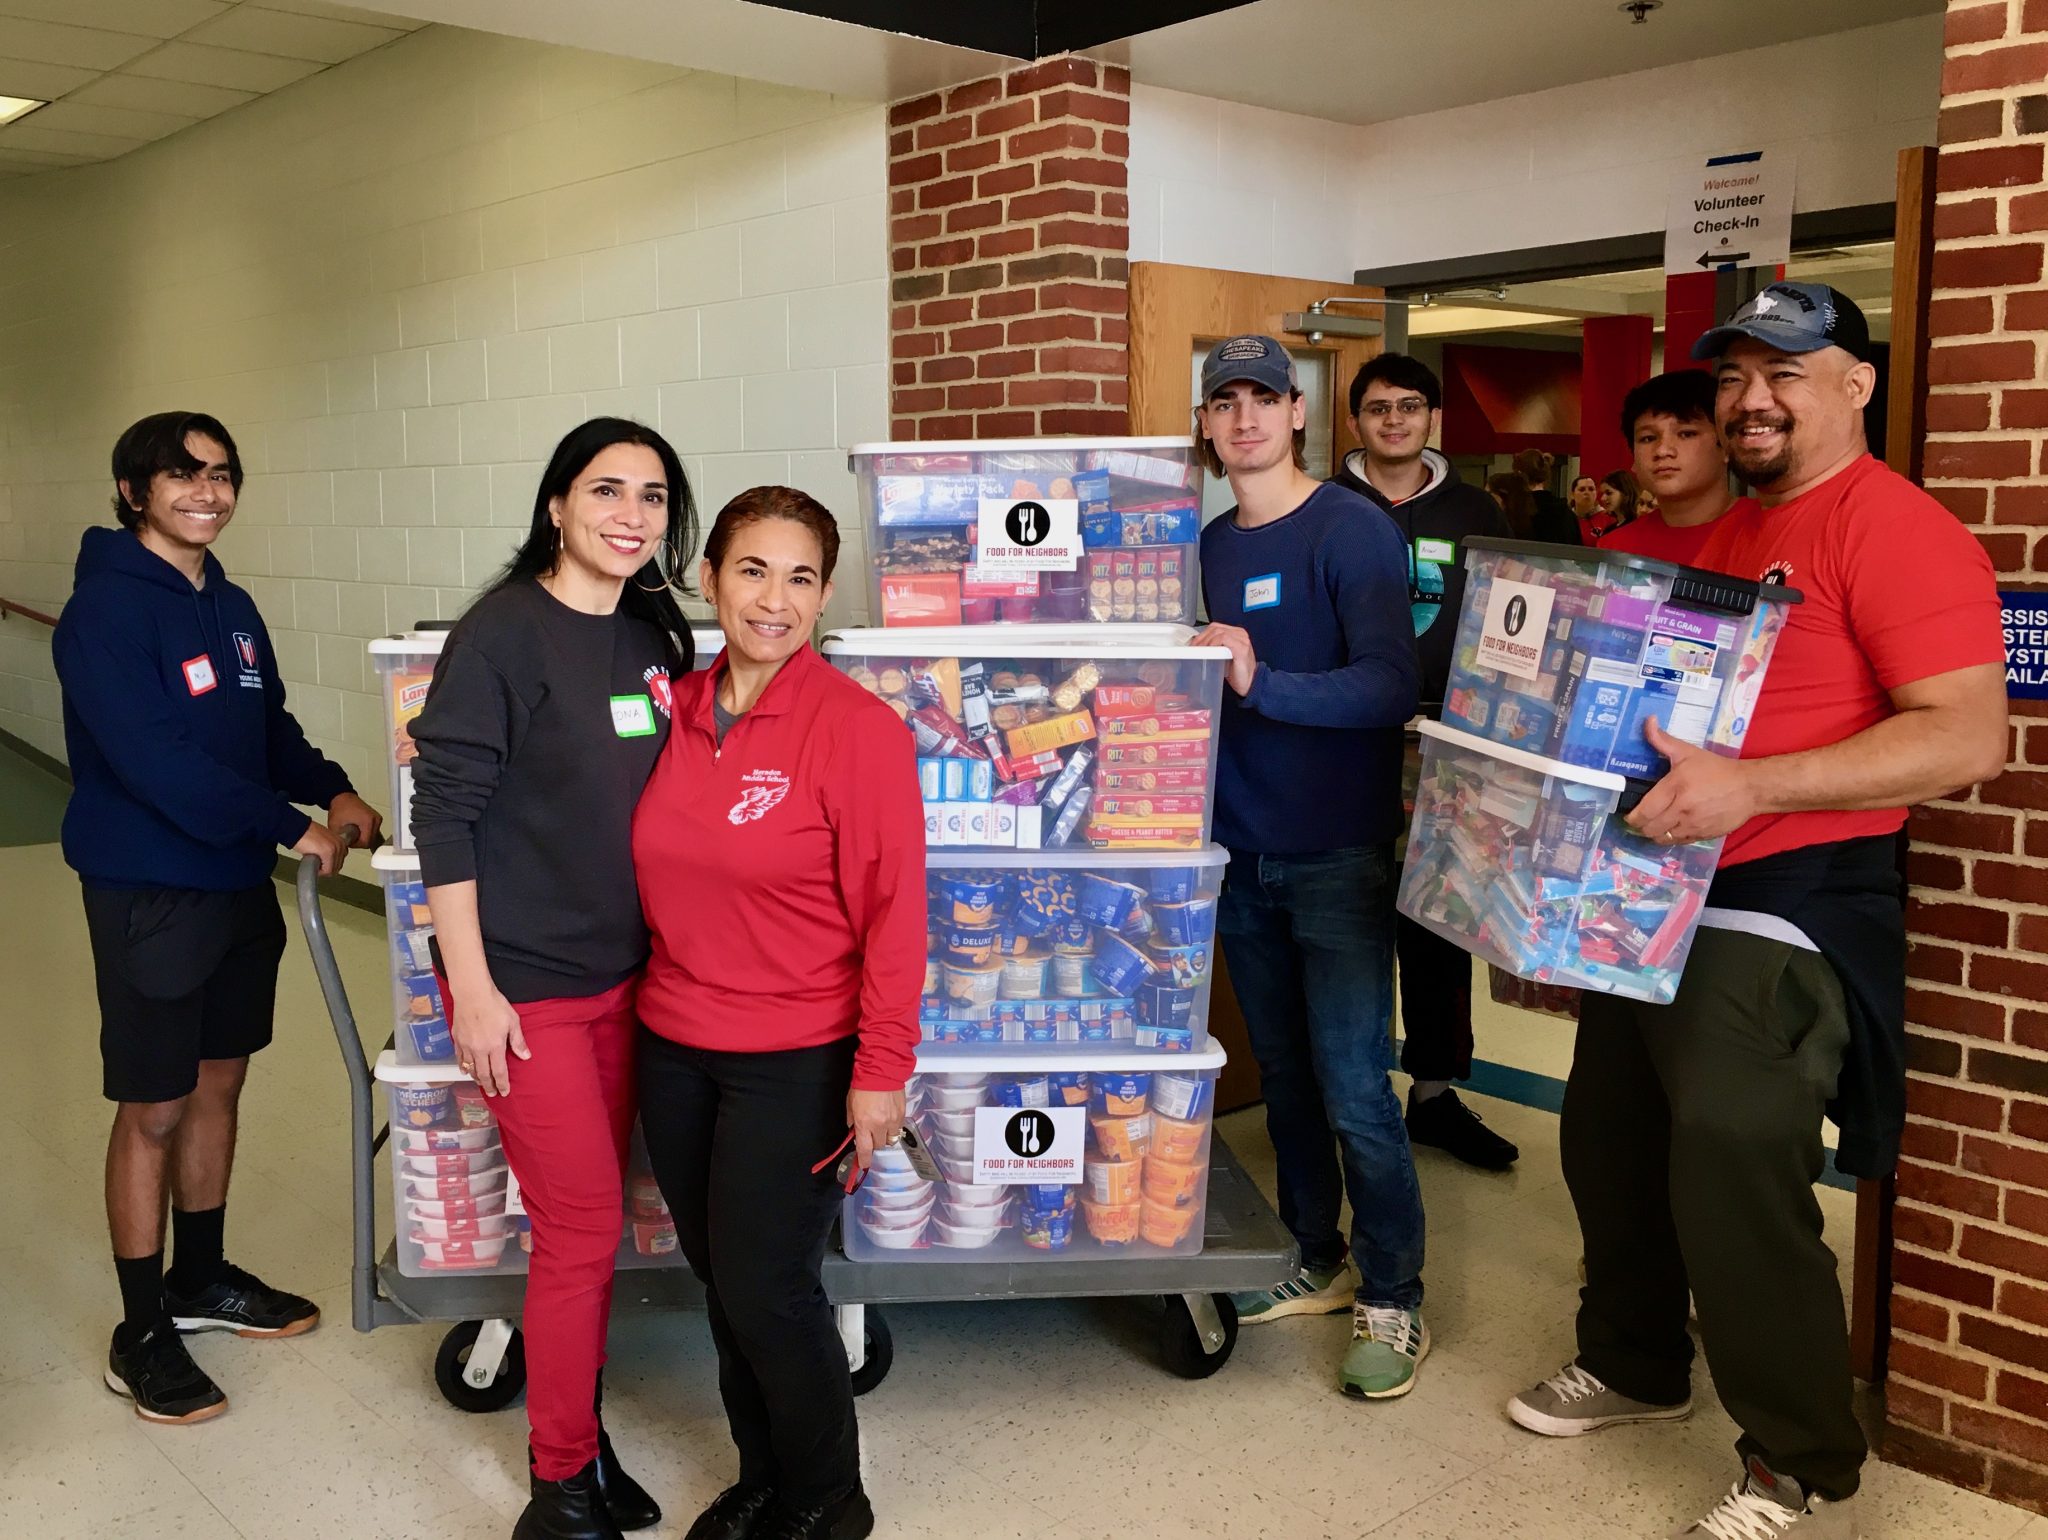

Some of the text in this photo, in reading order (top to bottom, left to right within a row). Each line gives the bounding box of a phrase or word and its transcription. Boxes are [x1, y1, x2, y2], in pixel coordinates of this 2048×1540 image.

[1703, 174, 1760, 191] Welcome!
[1694, 194, 1765, 212] Volunteer
[1693, 215, 1760, 234] Check-In
[986, 547, 1068, 557] FOOD FOR NEIGHBORS
[1092, 564, 1110, 577] RITZ
[1116, 562, 1134, 576] RITZ
[1138, 562, 1156, 575] RITZ
[1161, 560, 1178, 574] RITZ
[1644, 614, 1669, 625] FUIT
[1669, 618, 1676, 627] &
[1676, 620, 1702, 634] GRAIN
[1482, 635, 1496, 649] FOOD
[1496, 638, 1507, 651] FOR
[1506, 641, 1537, 660] NEIGHBORS
[1563, 676, 1575, 703] GRAIN
[1109, 721, 1126, 733] RITZ
[1107, 749, 1124, 760] RITZ
[1609, 757, 1649, 772] Blueberry
[1106, 775, 1122, 786] RITZ
[1103, 800, 1120, 812] RITZ
[962, 936, 992, 945] DELUXE
[983, 1159, 1075, 1169] FOOD FOR NEIGHBORS
